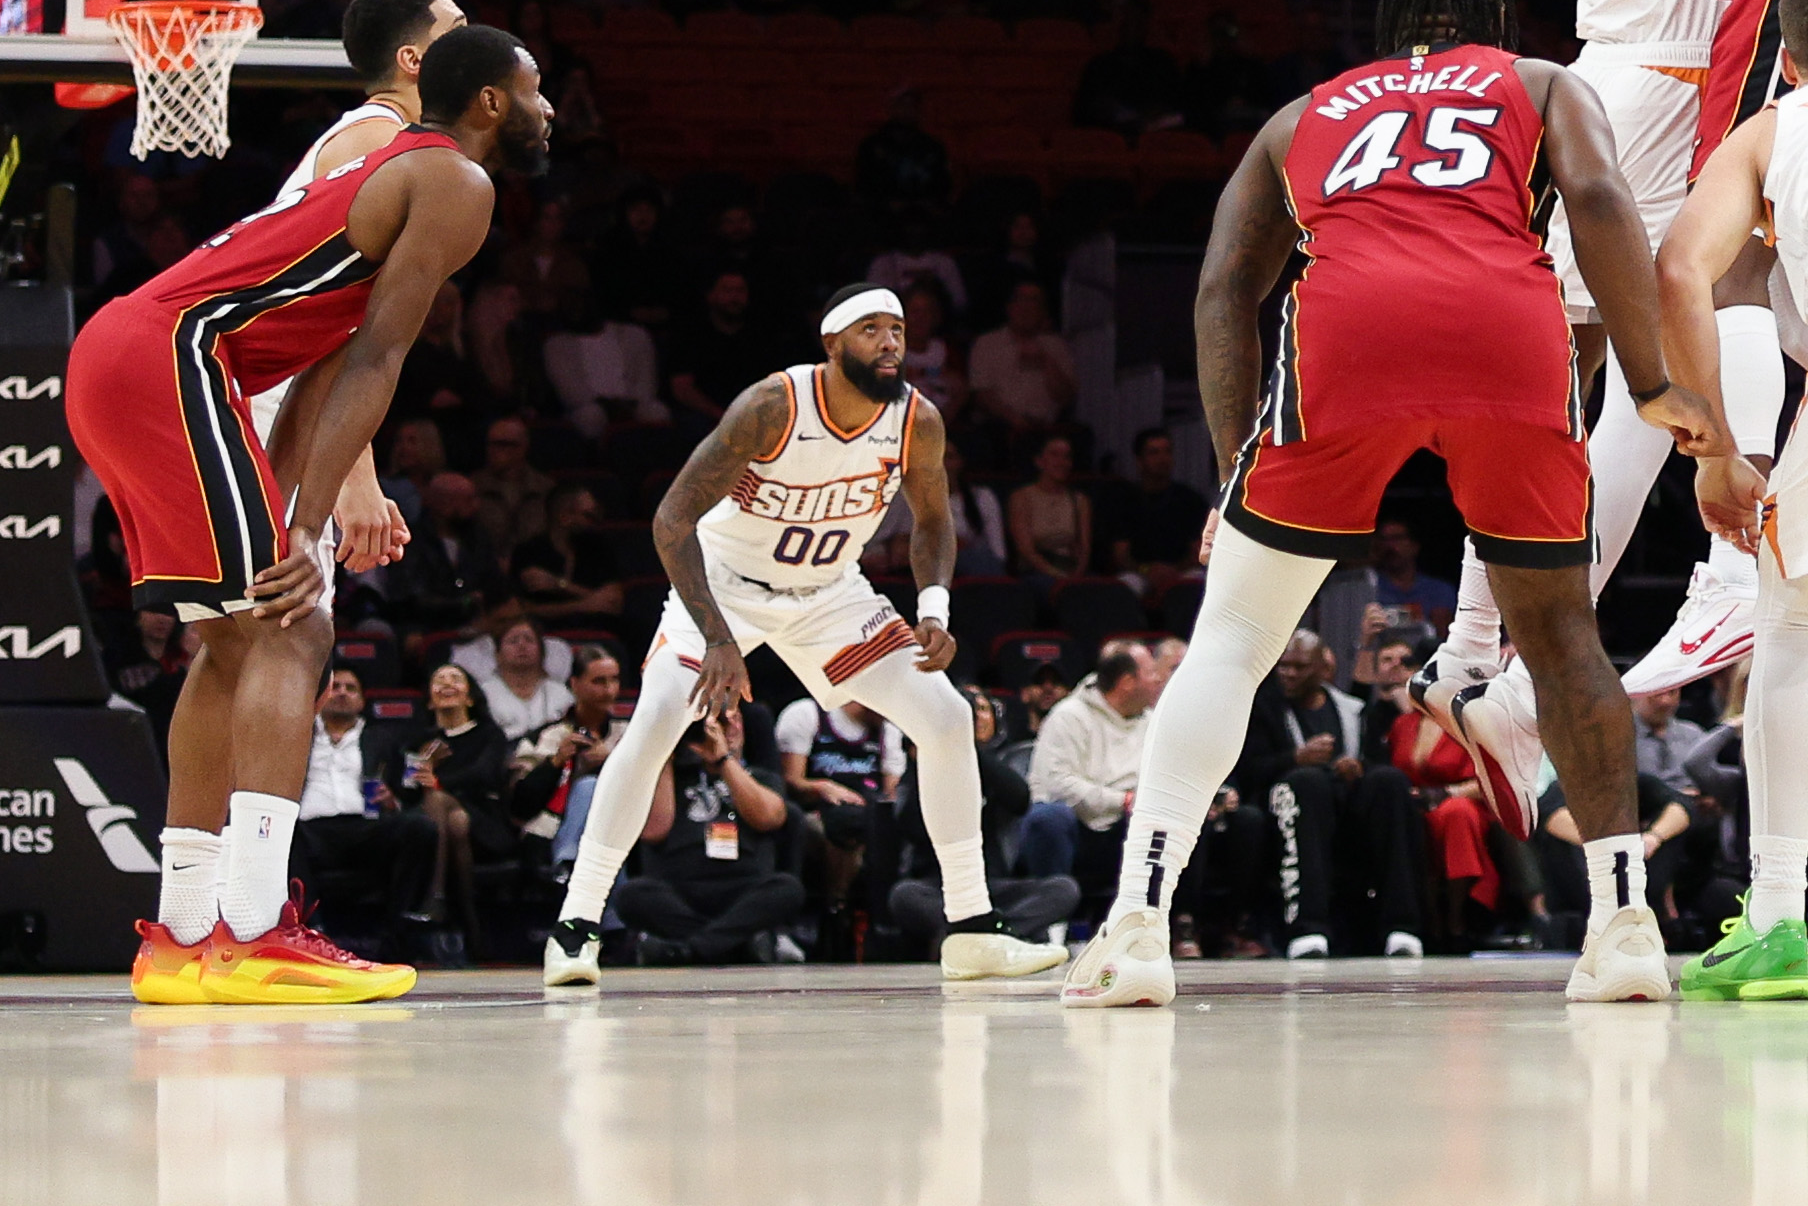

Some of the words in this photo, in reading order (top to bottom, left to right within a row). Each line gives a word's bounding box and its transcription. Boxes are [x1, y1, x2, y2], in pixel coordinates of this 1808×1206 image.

[1315, 65, 1502, 121] MITCHELL
[1321, 106, 1505, 200] 45
[751, 474, 879, 522] SUNS
[773, 525, 850, 567] 00
